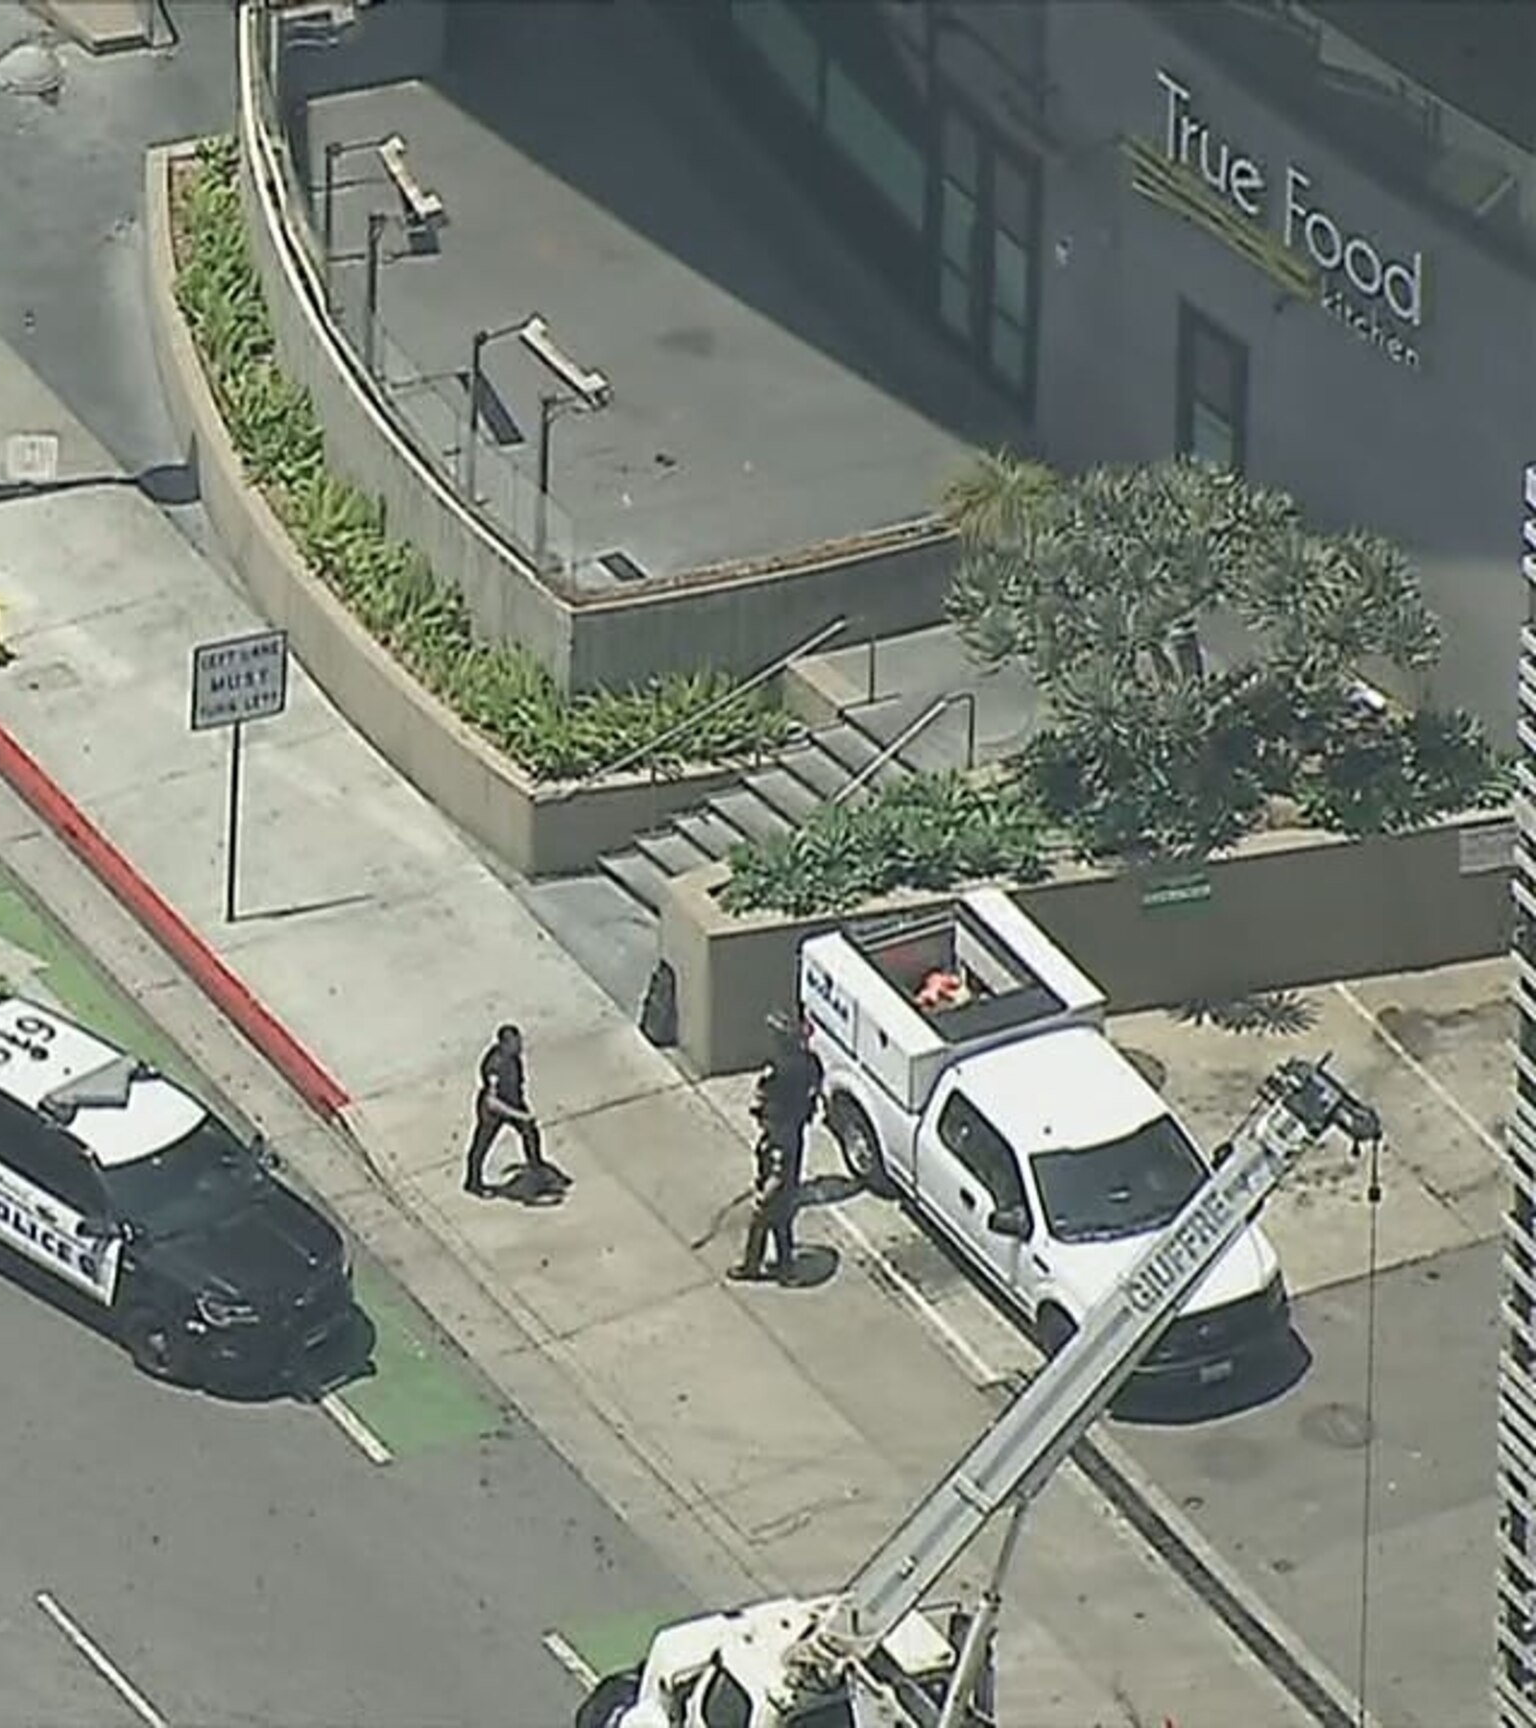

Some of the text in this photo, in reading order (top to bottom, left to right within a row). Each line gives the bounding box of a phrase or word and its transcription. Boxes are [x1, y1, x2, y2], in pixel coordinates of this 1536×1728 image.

[1157, 71, 1422, 325] True Food
[211, 668, 268, 693] MUST
[1128, 1192, 1234, 1314] GIUFFRE
